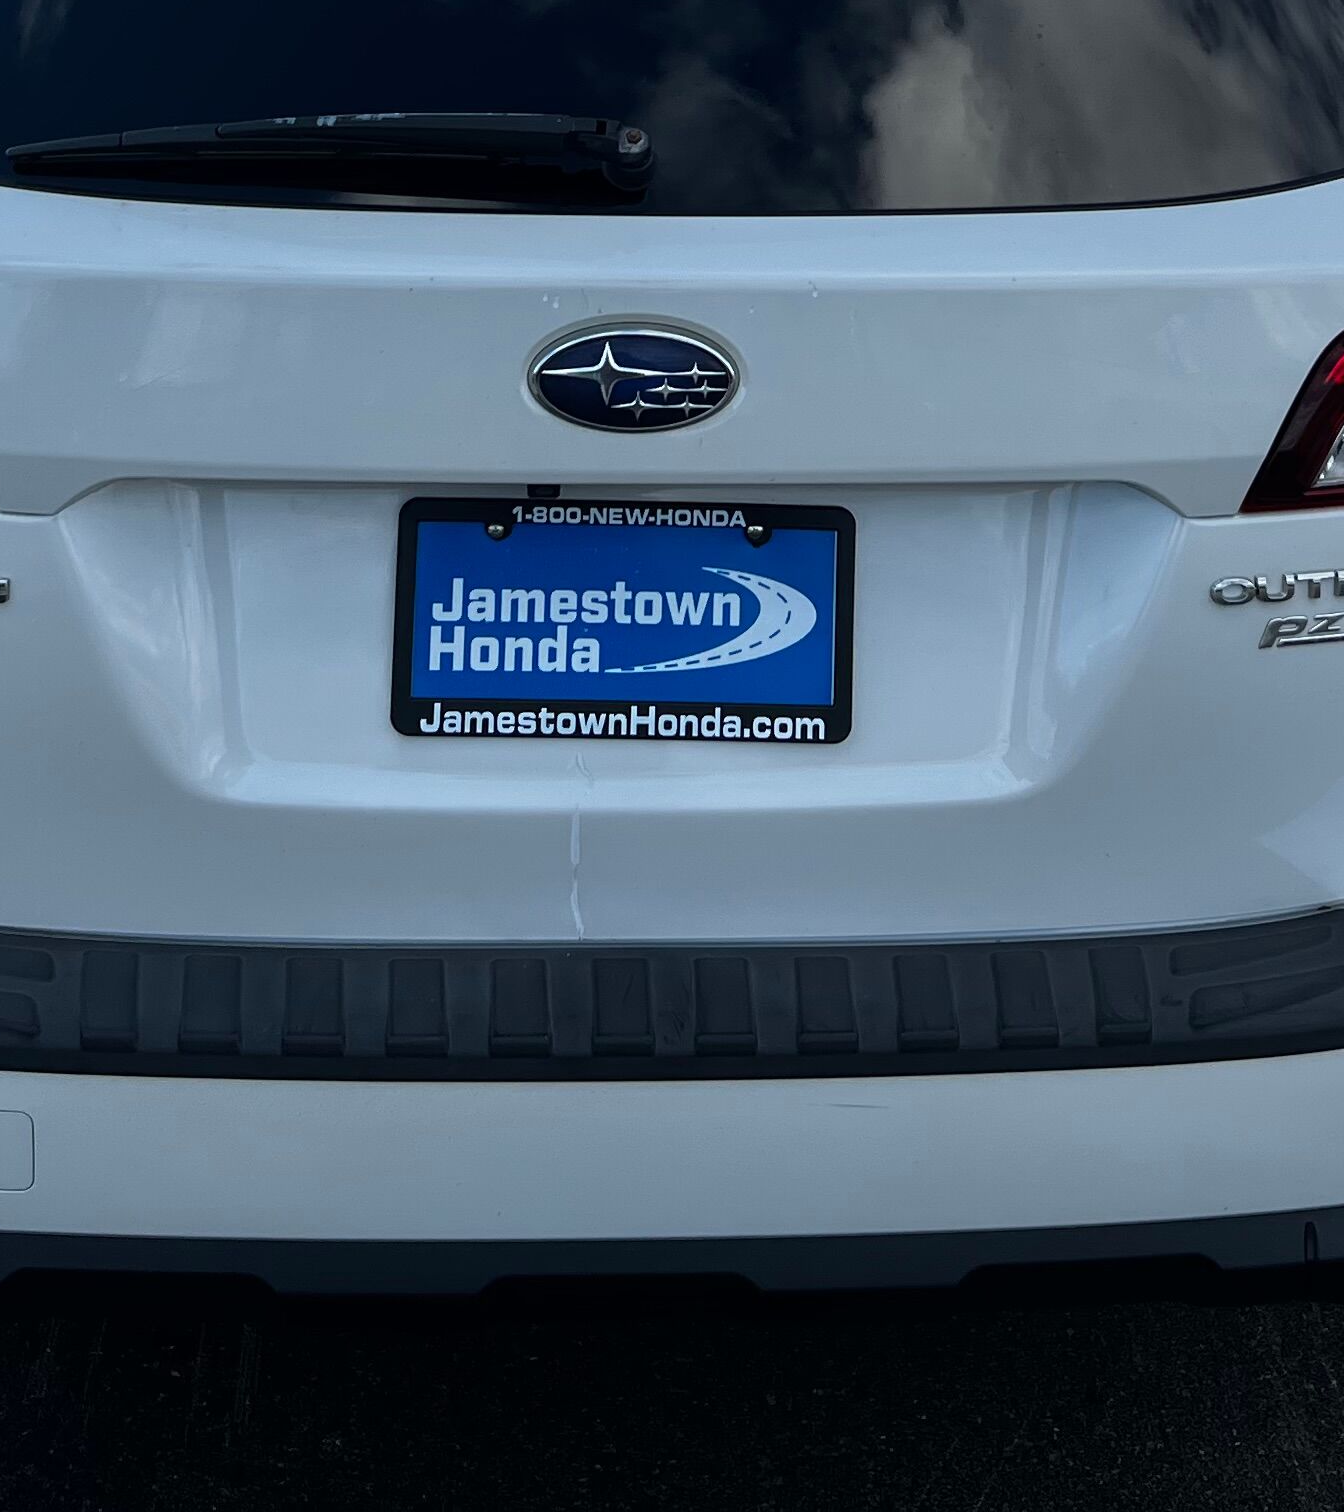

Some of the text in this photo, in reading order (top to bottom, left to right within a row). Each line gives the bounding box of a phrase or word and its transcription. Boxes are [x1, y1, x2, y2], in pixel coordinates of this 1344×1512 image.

[512, 505, 746, 528] 1-800-NEW-HONDA
[432, 577, 741, 627] Jamestown
[429, 625, 600, 673] Honda
[419, 702, 826, 740] JamestownHonda.com
